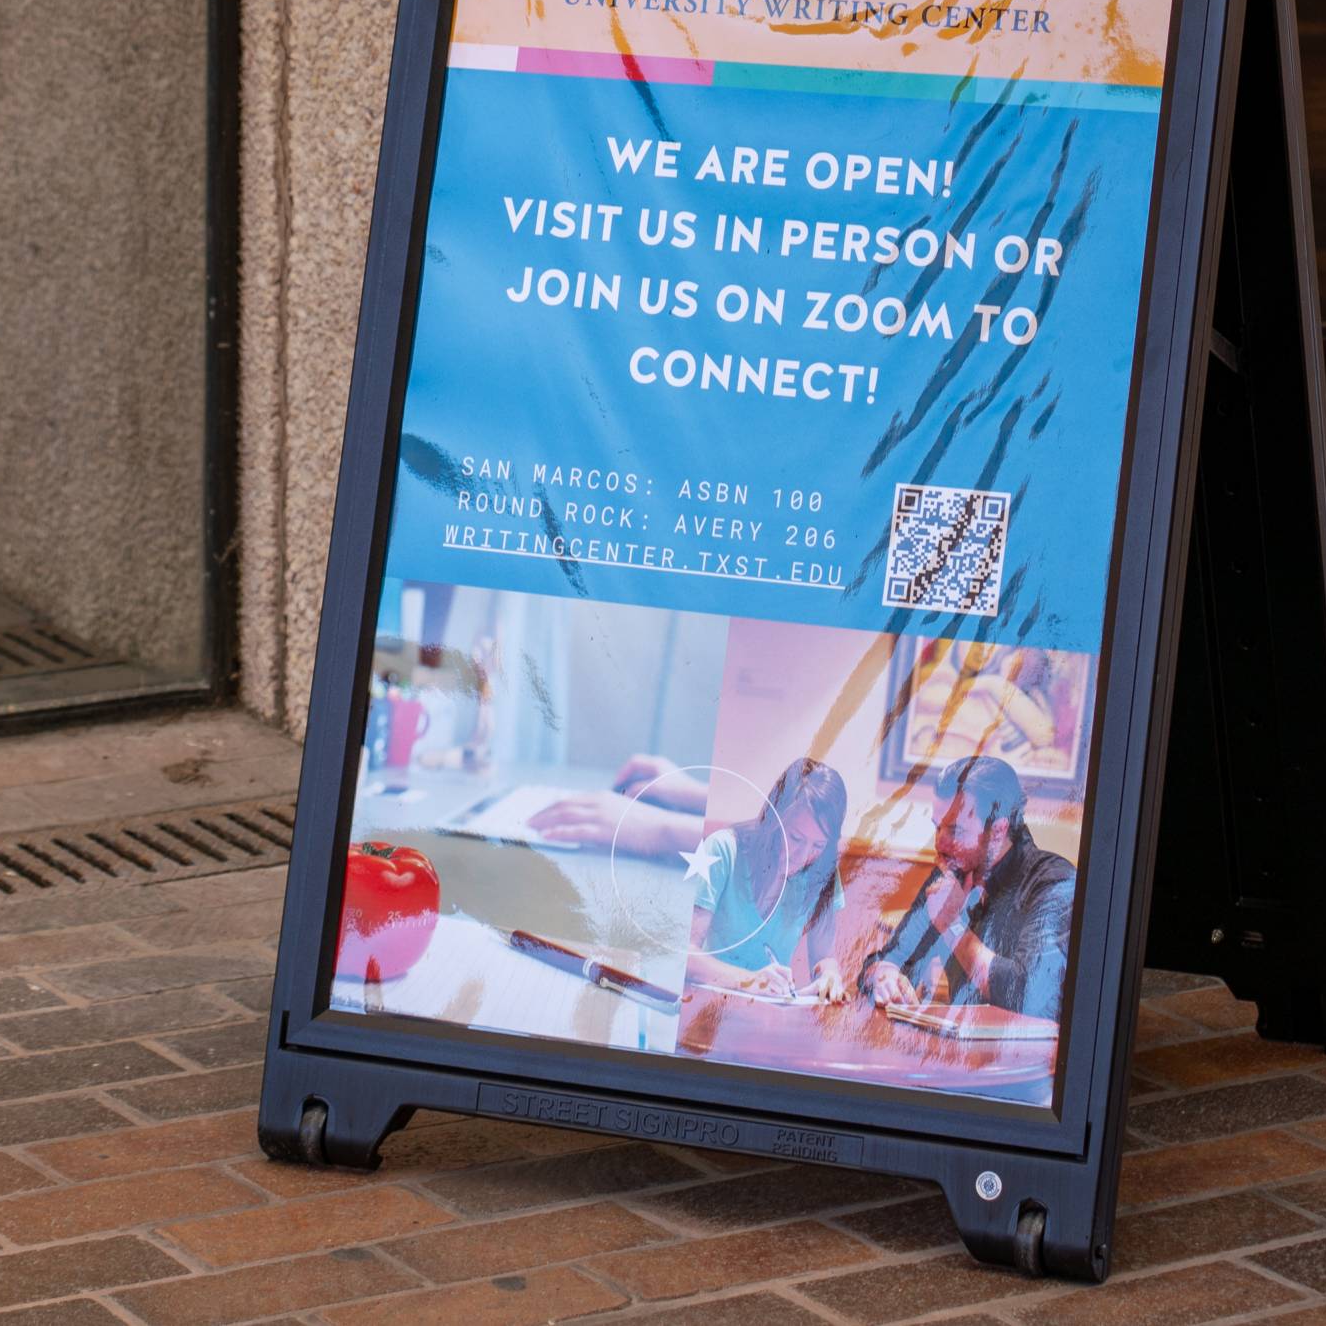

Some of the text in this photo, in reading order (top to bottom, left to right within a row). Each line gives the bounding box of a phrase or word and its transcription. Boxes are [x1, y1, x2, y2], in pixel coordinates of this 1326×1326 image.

[922, 4, 1051, 34] CENTER
[606, 137, 954, 197] WE ARE OPEN!
[504, 196, 1063, 276] VISIT US IN PERSON OR
[506, 267, 1037, 345] JOIN US ON ZOOM TO
[629, 346, 879, 404] CONNECT!
[461, 456, 823, 512] SAN MARCOS: ASBN 100
[458, 491, 836, 550] ROUND ROCK: AVERY 206
[444, 524, 844, 587] WRITINGCENTER.TXST.EDU
[502, 1092, 740, 1146] STREET SIGNPRO
[776, 1129, 836, 1147] PATENT
[772, 1143, 838, 1163] PENDING
